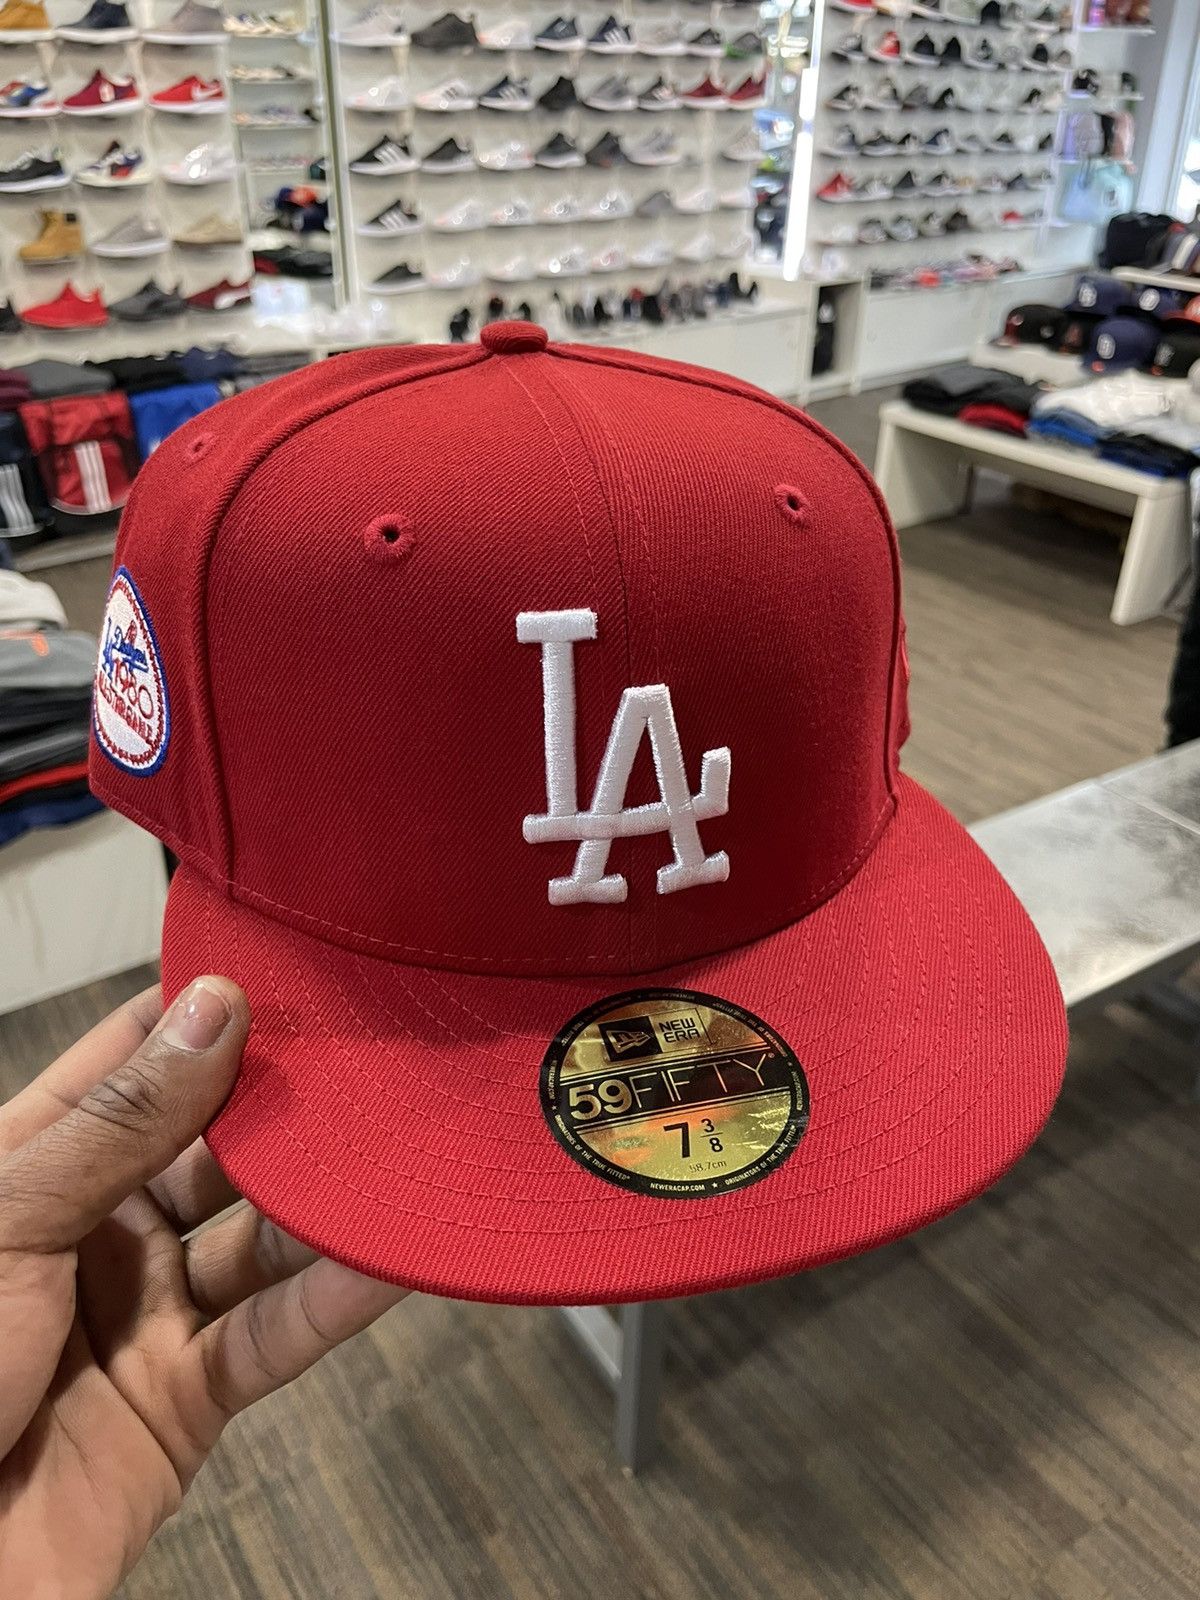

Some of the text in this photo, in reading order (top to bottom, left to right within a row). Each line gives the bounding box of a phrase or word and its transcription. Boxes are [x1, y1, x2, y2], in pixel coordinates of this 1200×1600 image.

[115, 658, 154, 720] 1980
[516, 607, 731, 905] LA
[658, 1017, 696, 1032] NEW
[664, 1028, 700, 1043] ERA
[663, 1122, 691, 1159] 7
[581, 1149, 592, 1162] THE
[590, 1157, 606, 1171] TRUE
[725, 1166, 761, 1185] ORIGINATORS
[759, 1160, 769, 1169] OF
[766, 1152, 779, 1164] THE
[650, 1180, 706, 1192] NEWERACAP.COM
